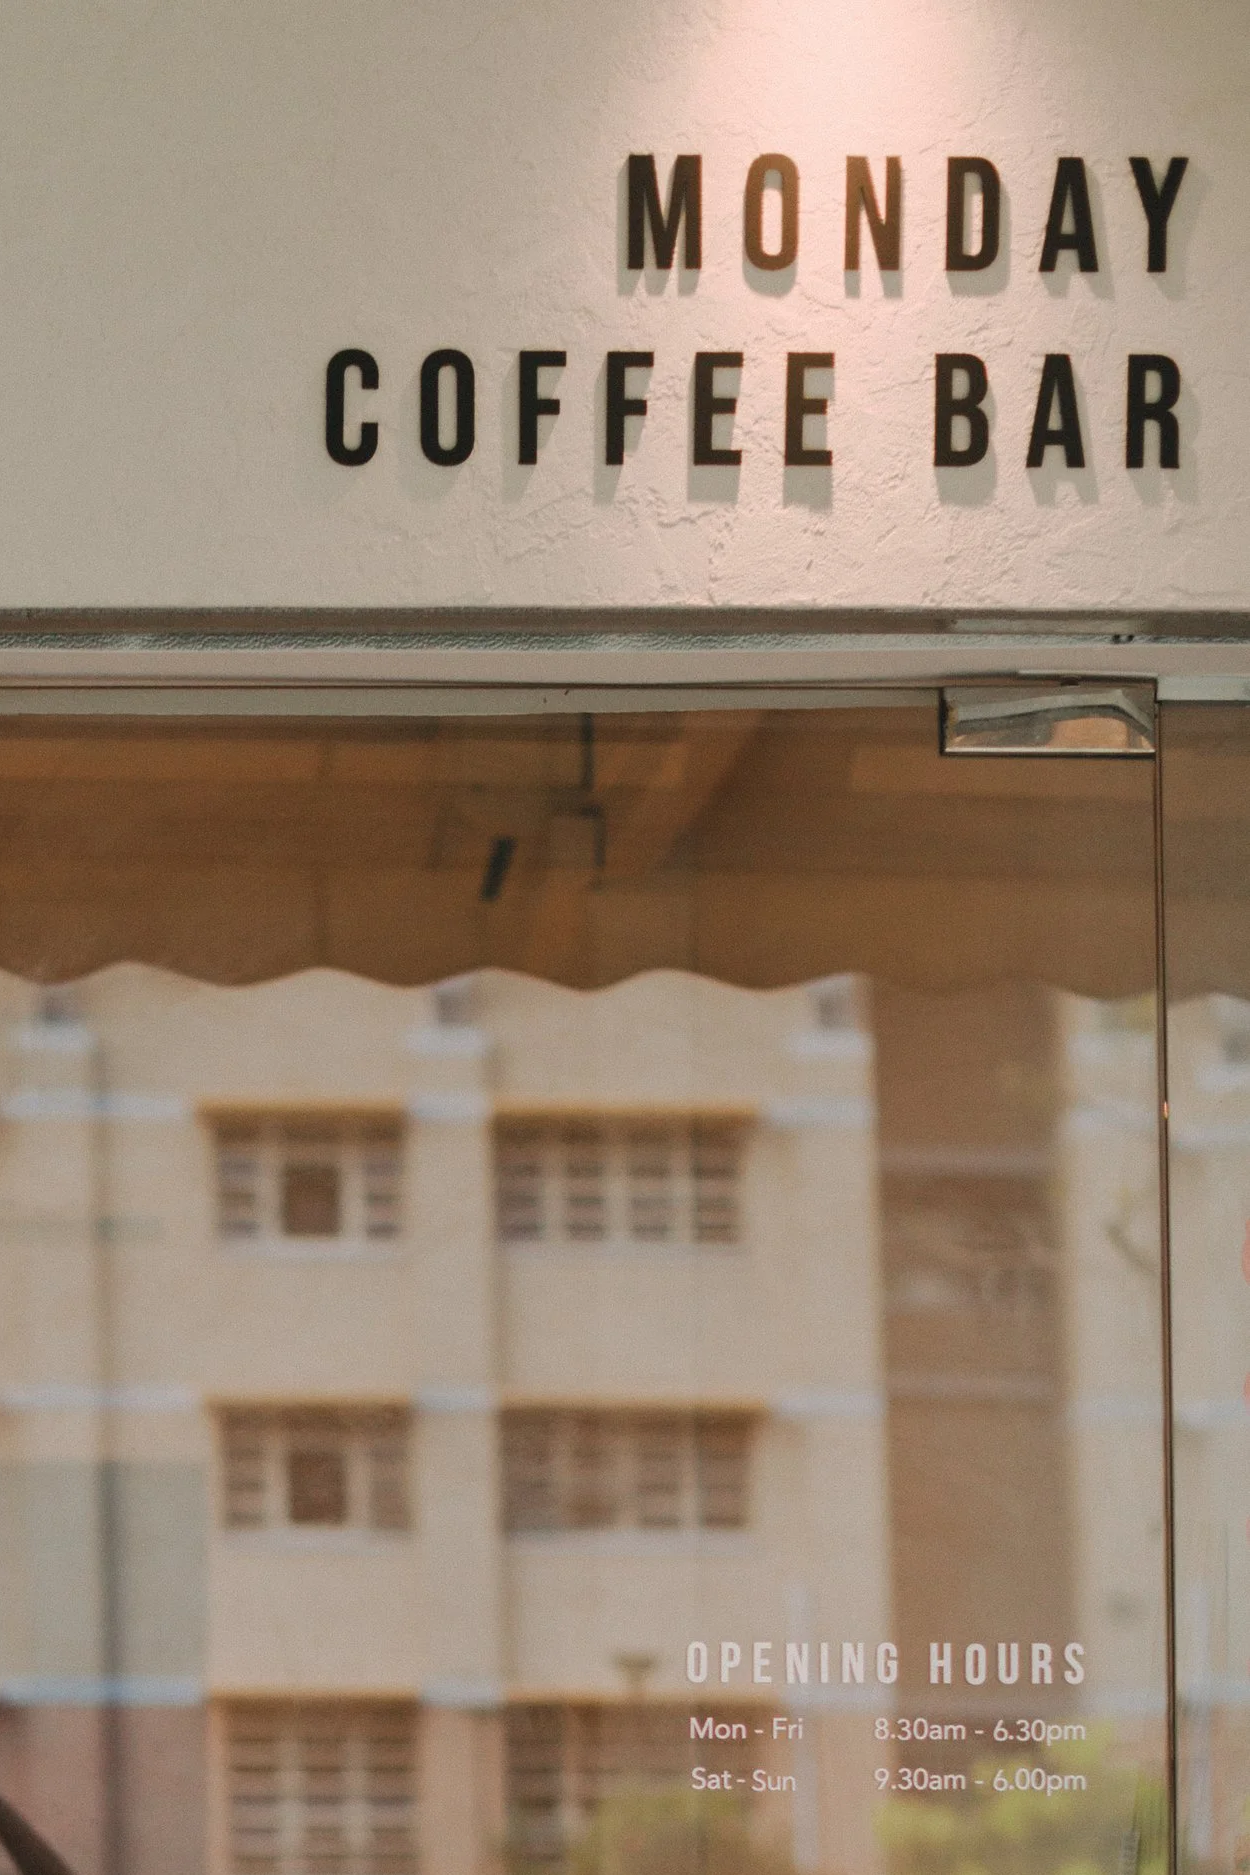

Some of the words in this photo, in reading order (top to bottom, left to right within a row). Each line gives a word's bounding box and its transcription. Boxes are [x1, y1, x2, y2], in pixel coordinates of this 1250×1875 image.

[627, 153, 1189, 274] MONDAY
[324, 348, 835, 467] COFFEE
[934, 353, 1182, 470] BAR
[687, 1641, 899, 1684] OPENING
[929, 1642, 1085, 1686] HOURS
[689, 1716, 747, 1740] Mon
[772, 1716, 803, 1740] Fri
[874, 1718, 966, 1741] 8.30am
[993, 1719, 1086, 1746] 6.30pm
[691, 1767, 733, 1790] Sat
[751, 1769, 796, 1792] Sun
[874, 1767, 966, 1791] 9.30am
[993, 1768, 1086, 1796] 6.00pm
